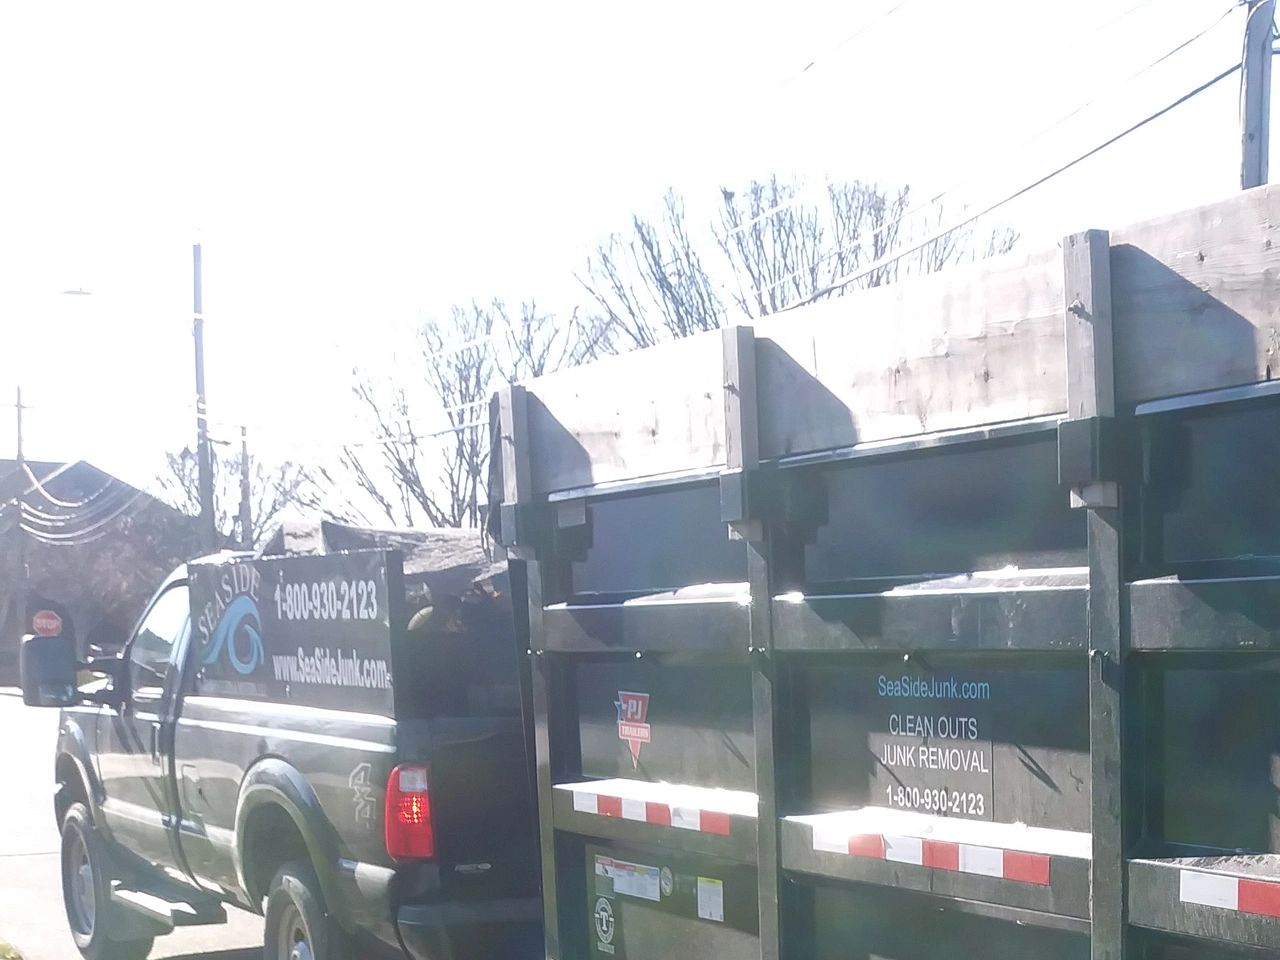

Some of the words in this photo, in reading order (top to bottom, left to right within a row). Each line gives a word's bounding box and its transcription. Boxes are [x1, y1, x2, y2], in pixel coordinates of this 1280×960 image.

[198, 563, 261, 645] SEASIDE
[274, 580, 378, 620] 1-800-930-2123
[272, 647, 388, 689] www.SeaSideJunk.com
[878, 675, 990, 700] SeaSideJunk.com
[627, 699, 643, 719] PJ
[889, 714, 934, 737] CLEAN
[938, 716, 978, 740] OUTS
[880, 744, 916, 768] JUNK
[919, 747, 989, 773] REMOVAL
[886, 784, 985, 815] 1-800-930-2123
